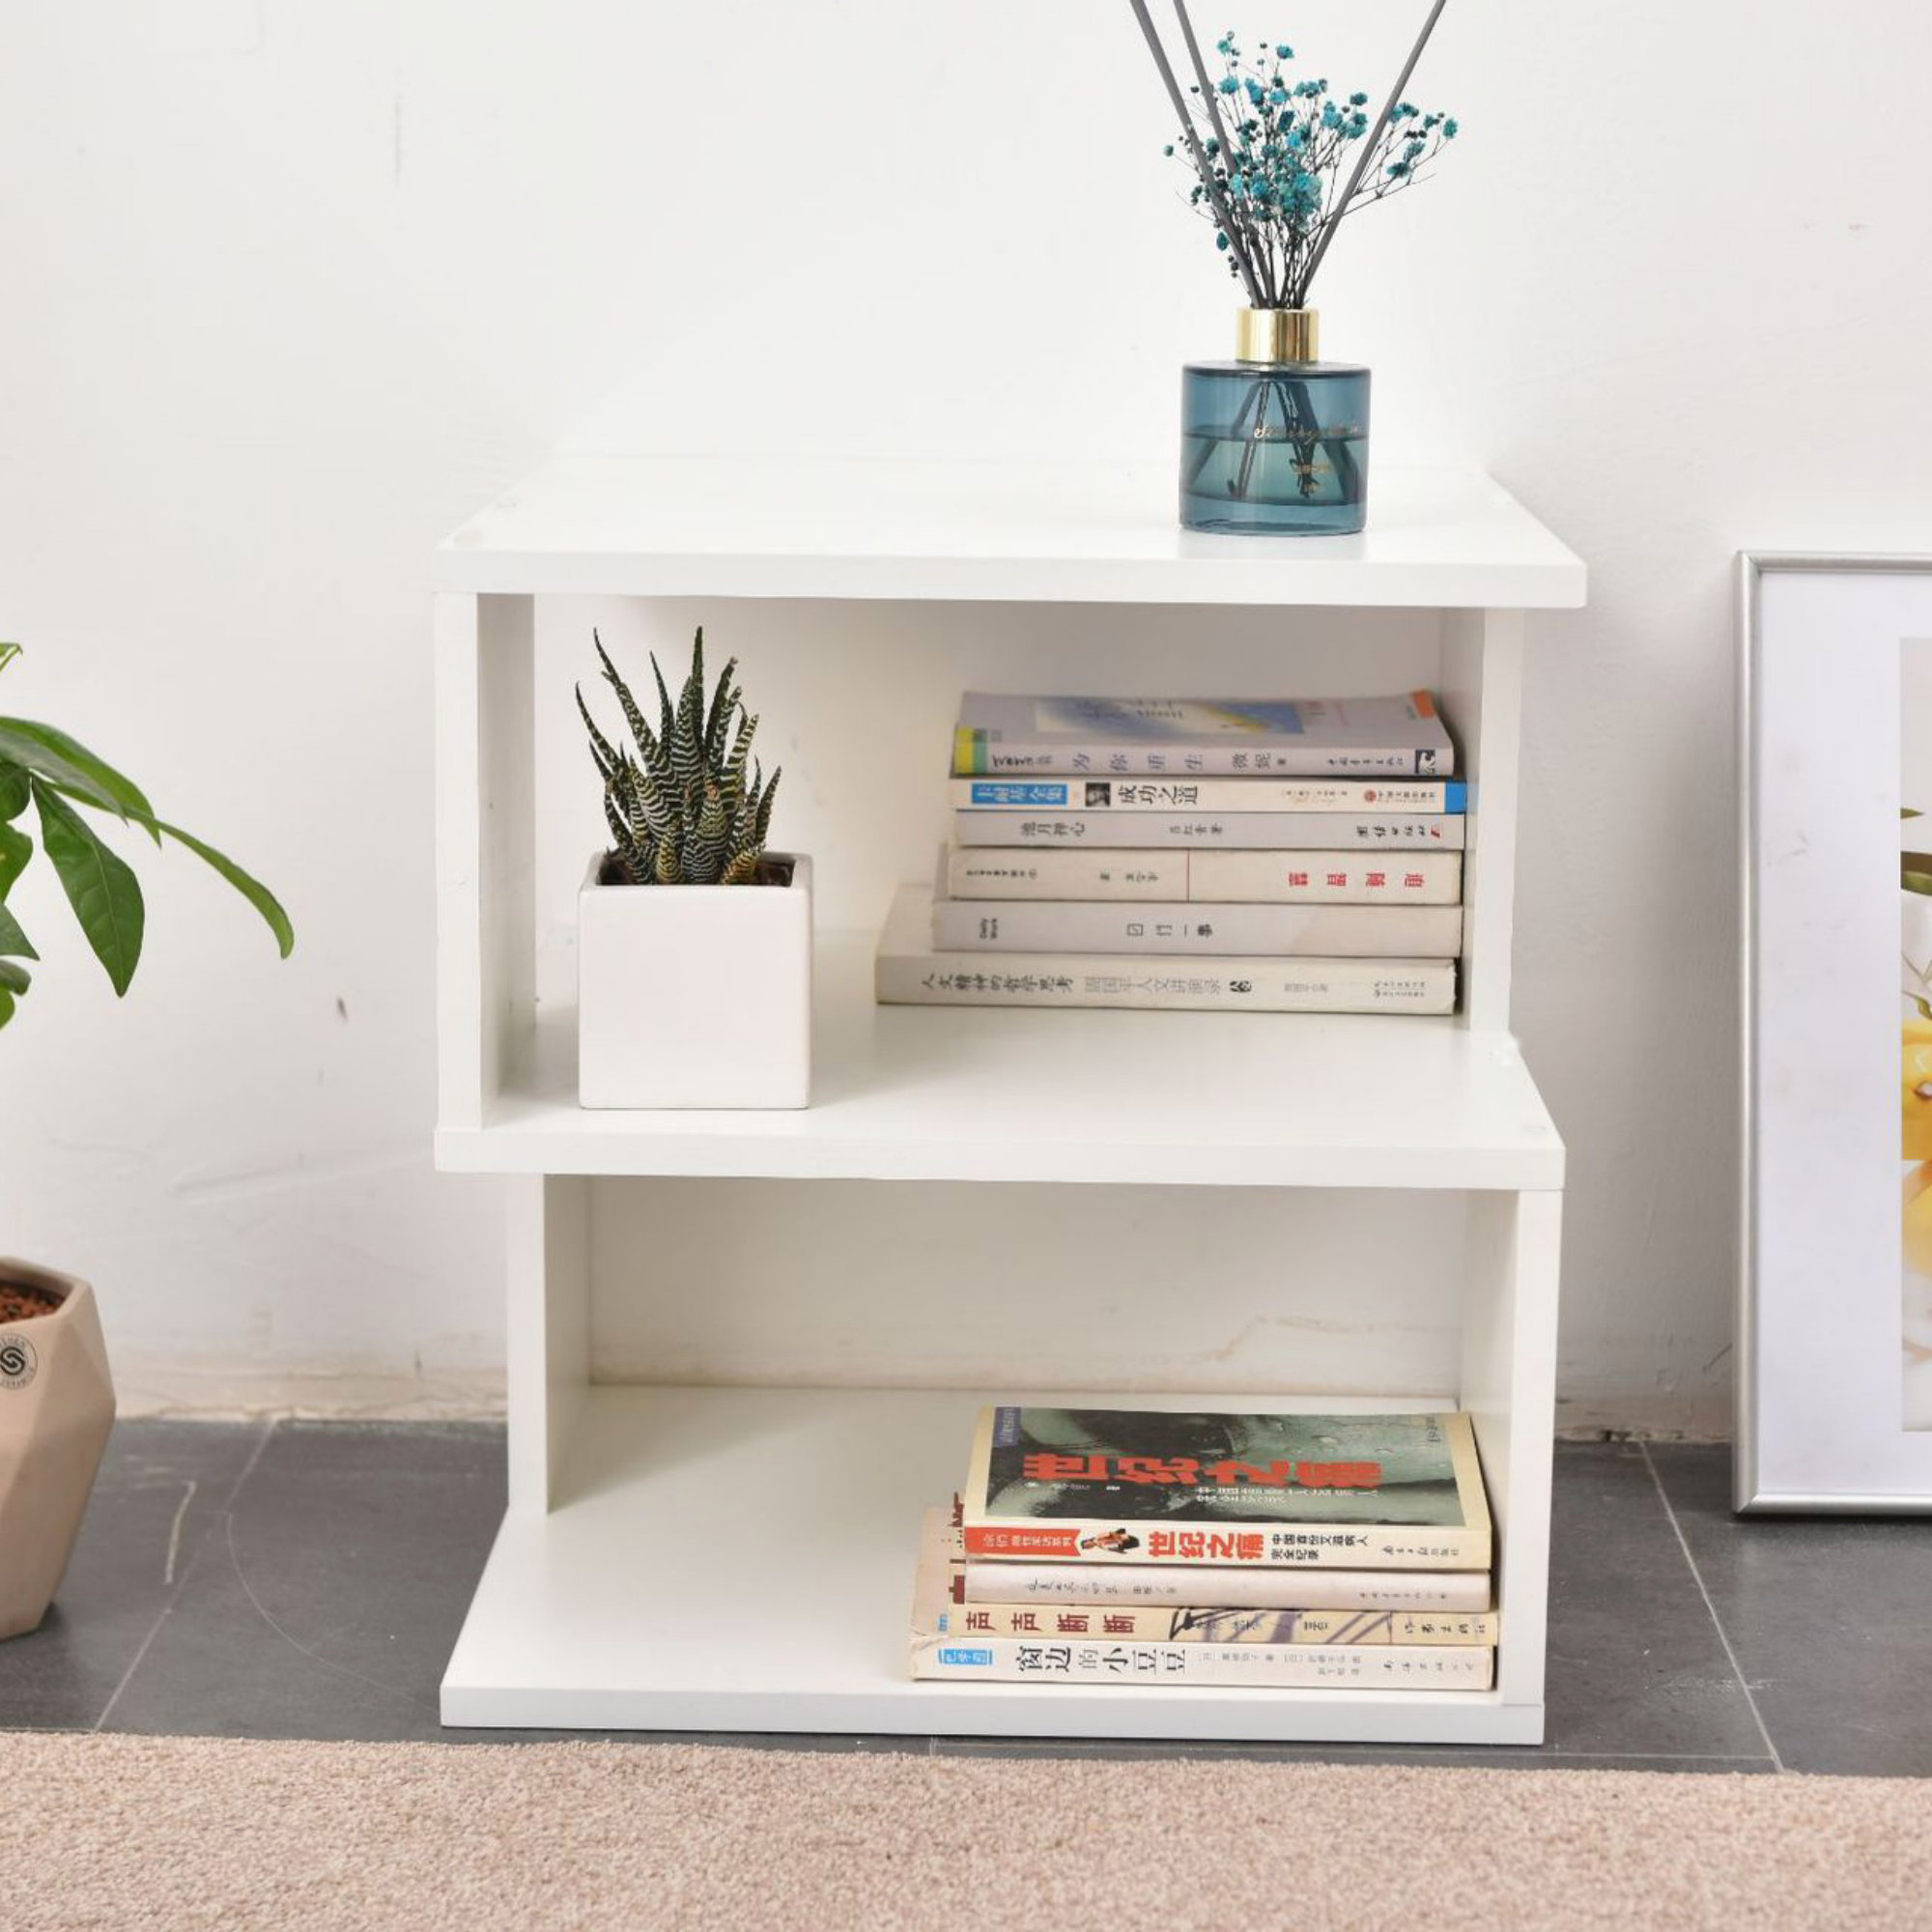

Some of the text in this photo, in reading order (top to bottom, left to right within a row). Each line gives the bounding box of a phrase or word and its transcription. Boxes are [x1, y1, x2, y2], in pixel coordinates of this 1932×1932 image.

[1117, 783, 1199, 806] 成功之道
[1023, 1453, 1383, 1489] 世纪之痛
[1148, 1531, 1264, 1560] 世纪之痛
[966, 1610, 1137, 1634] 声声断断
[1015, 1644, 1186, 1675] 窗边的小豆豆
